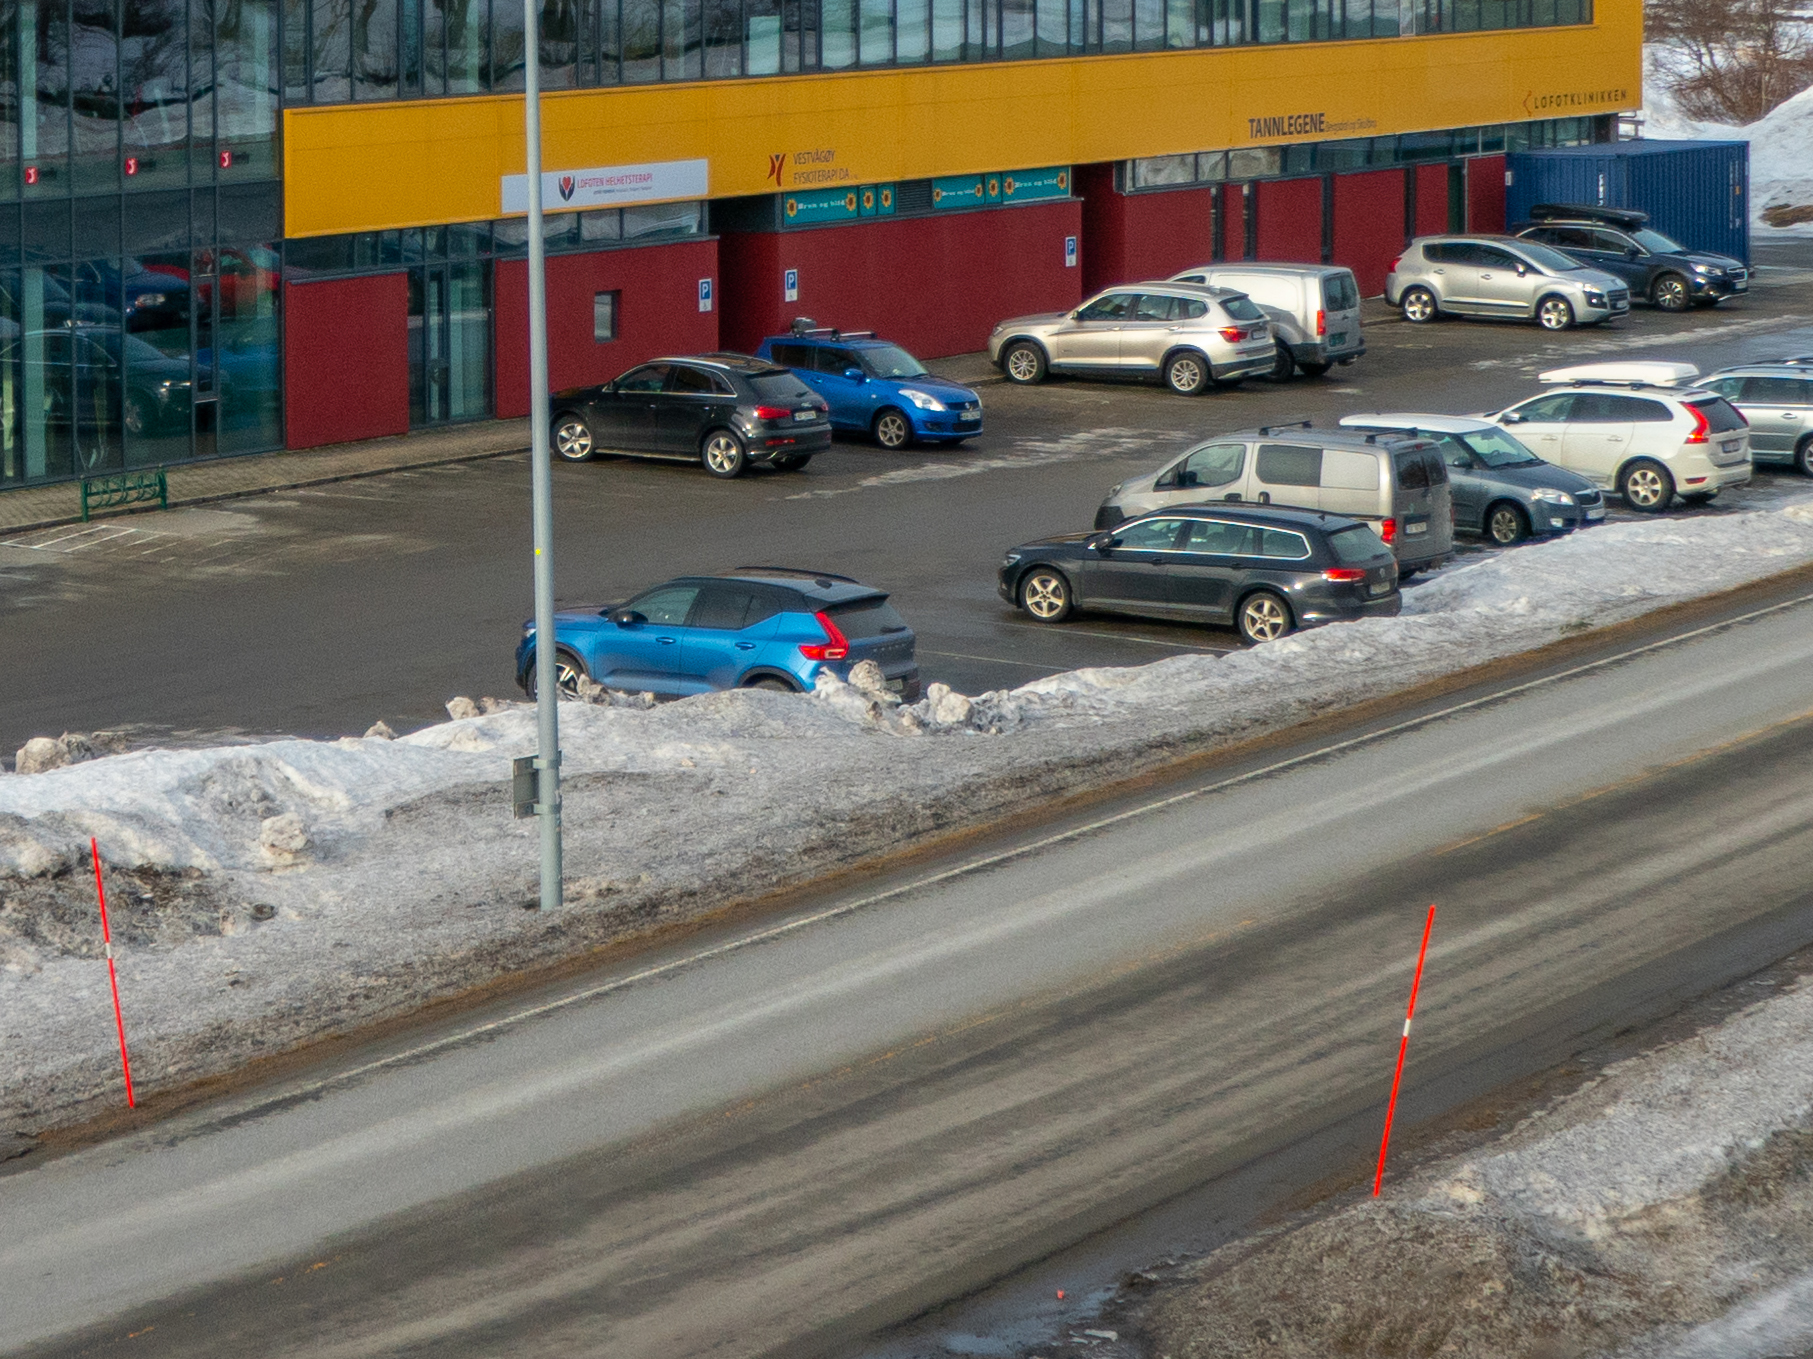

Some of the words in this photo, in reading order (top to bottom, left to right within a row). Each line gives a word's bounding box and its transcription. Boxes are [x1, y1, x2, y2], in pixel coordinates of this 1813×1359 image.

[1534, 89, 1627, 109] LOFOTKLINIKKEN
[1248, 112, 1325, 138] TANNLEGENE
[1068, 241, 1074, 253] P
[788, 274, 794, 288] P
[702, 284, 709, 297] P
